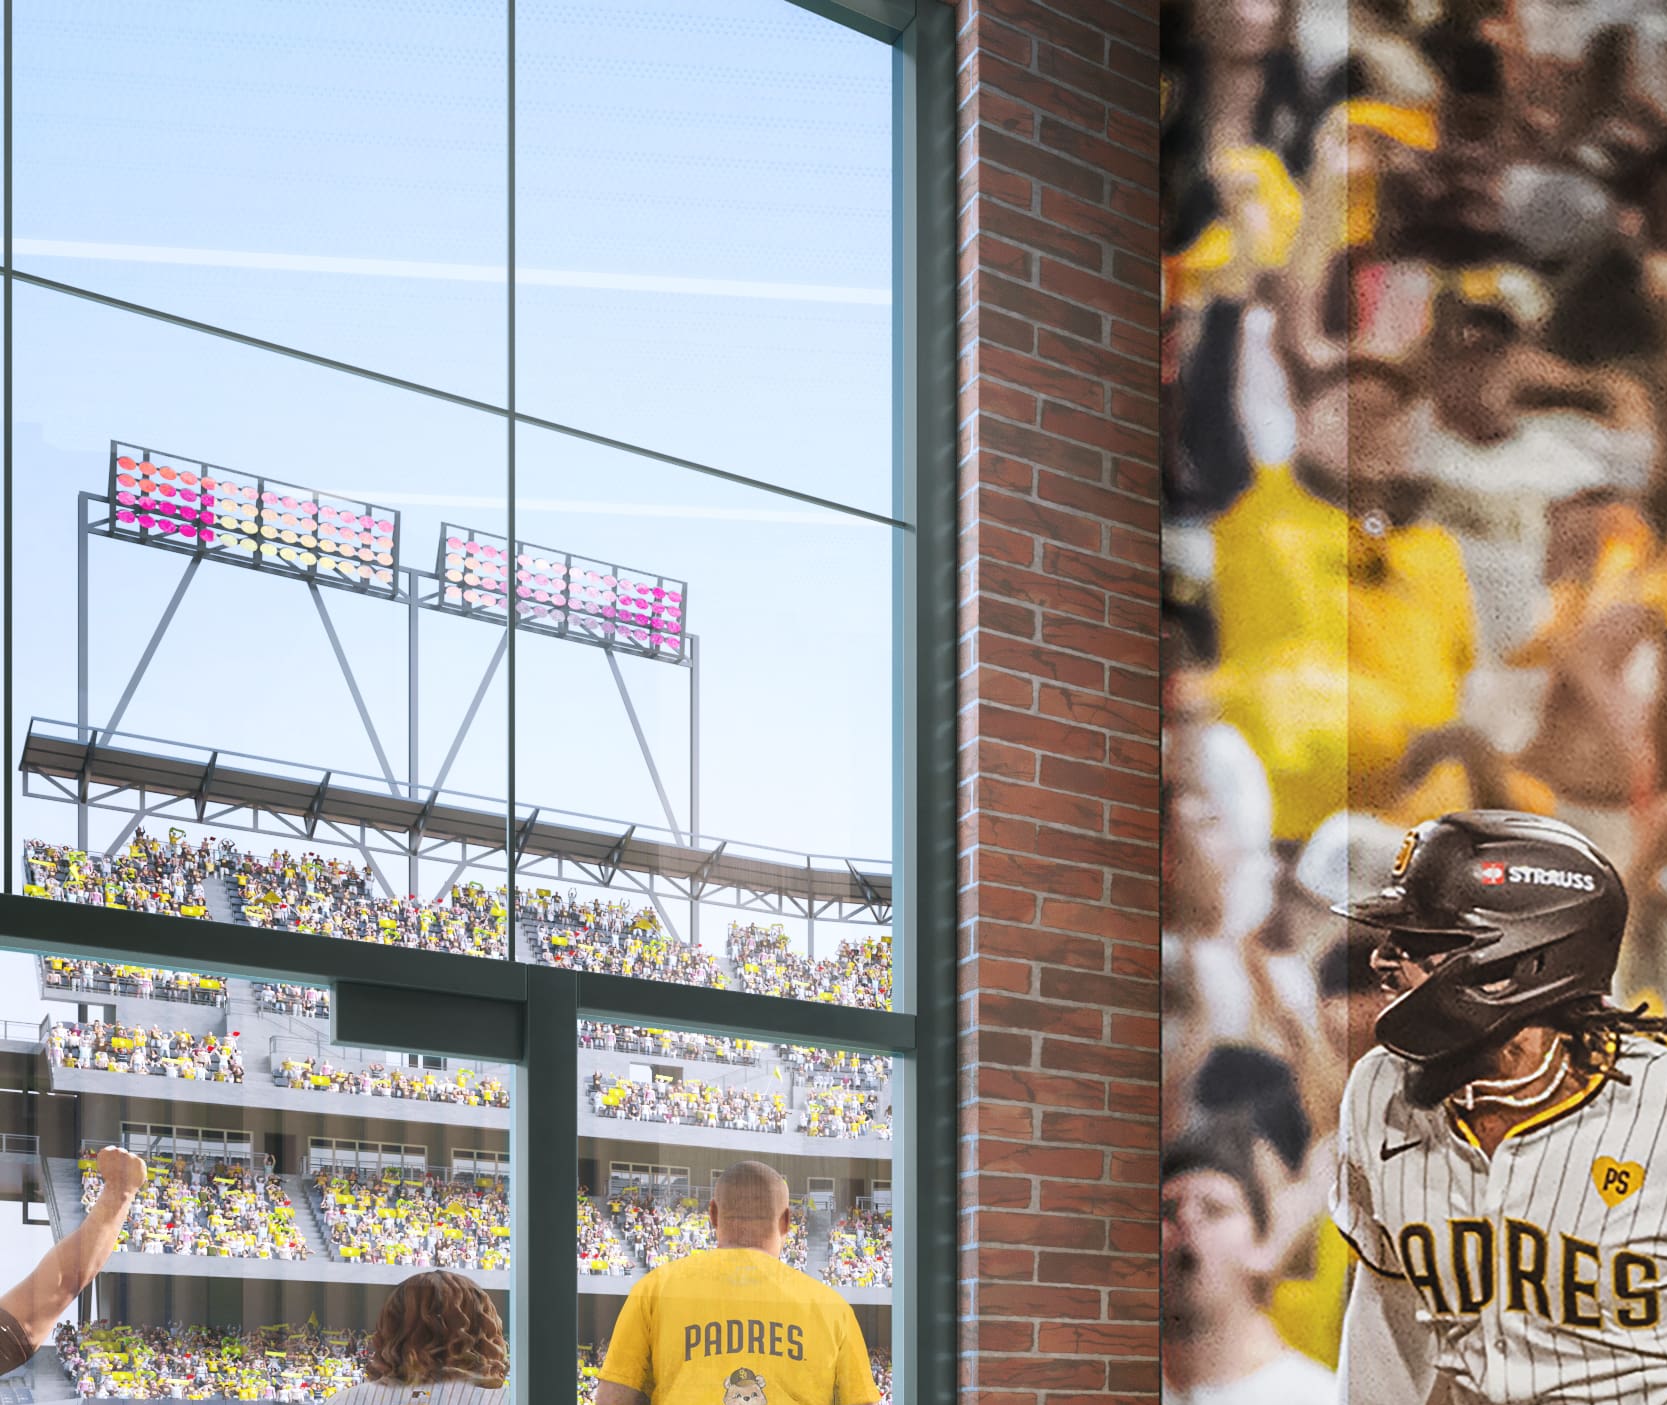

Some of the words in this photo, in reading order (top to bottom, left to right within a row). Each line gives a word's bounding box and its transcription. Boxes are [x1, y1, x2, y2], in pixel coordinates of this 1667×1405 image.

[1508, 865, 1596, 892] STRAUSS
[1602, 1166, 1631, 1195] PS
[1398, 1215, 1661, 1331] ADRES
[684, 1319, 804, 1361] PADRES
